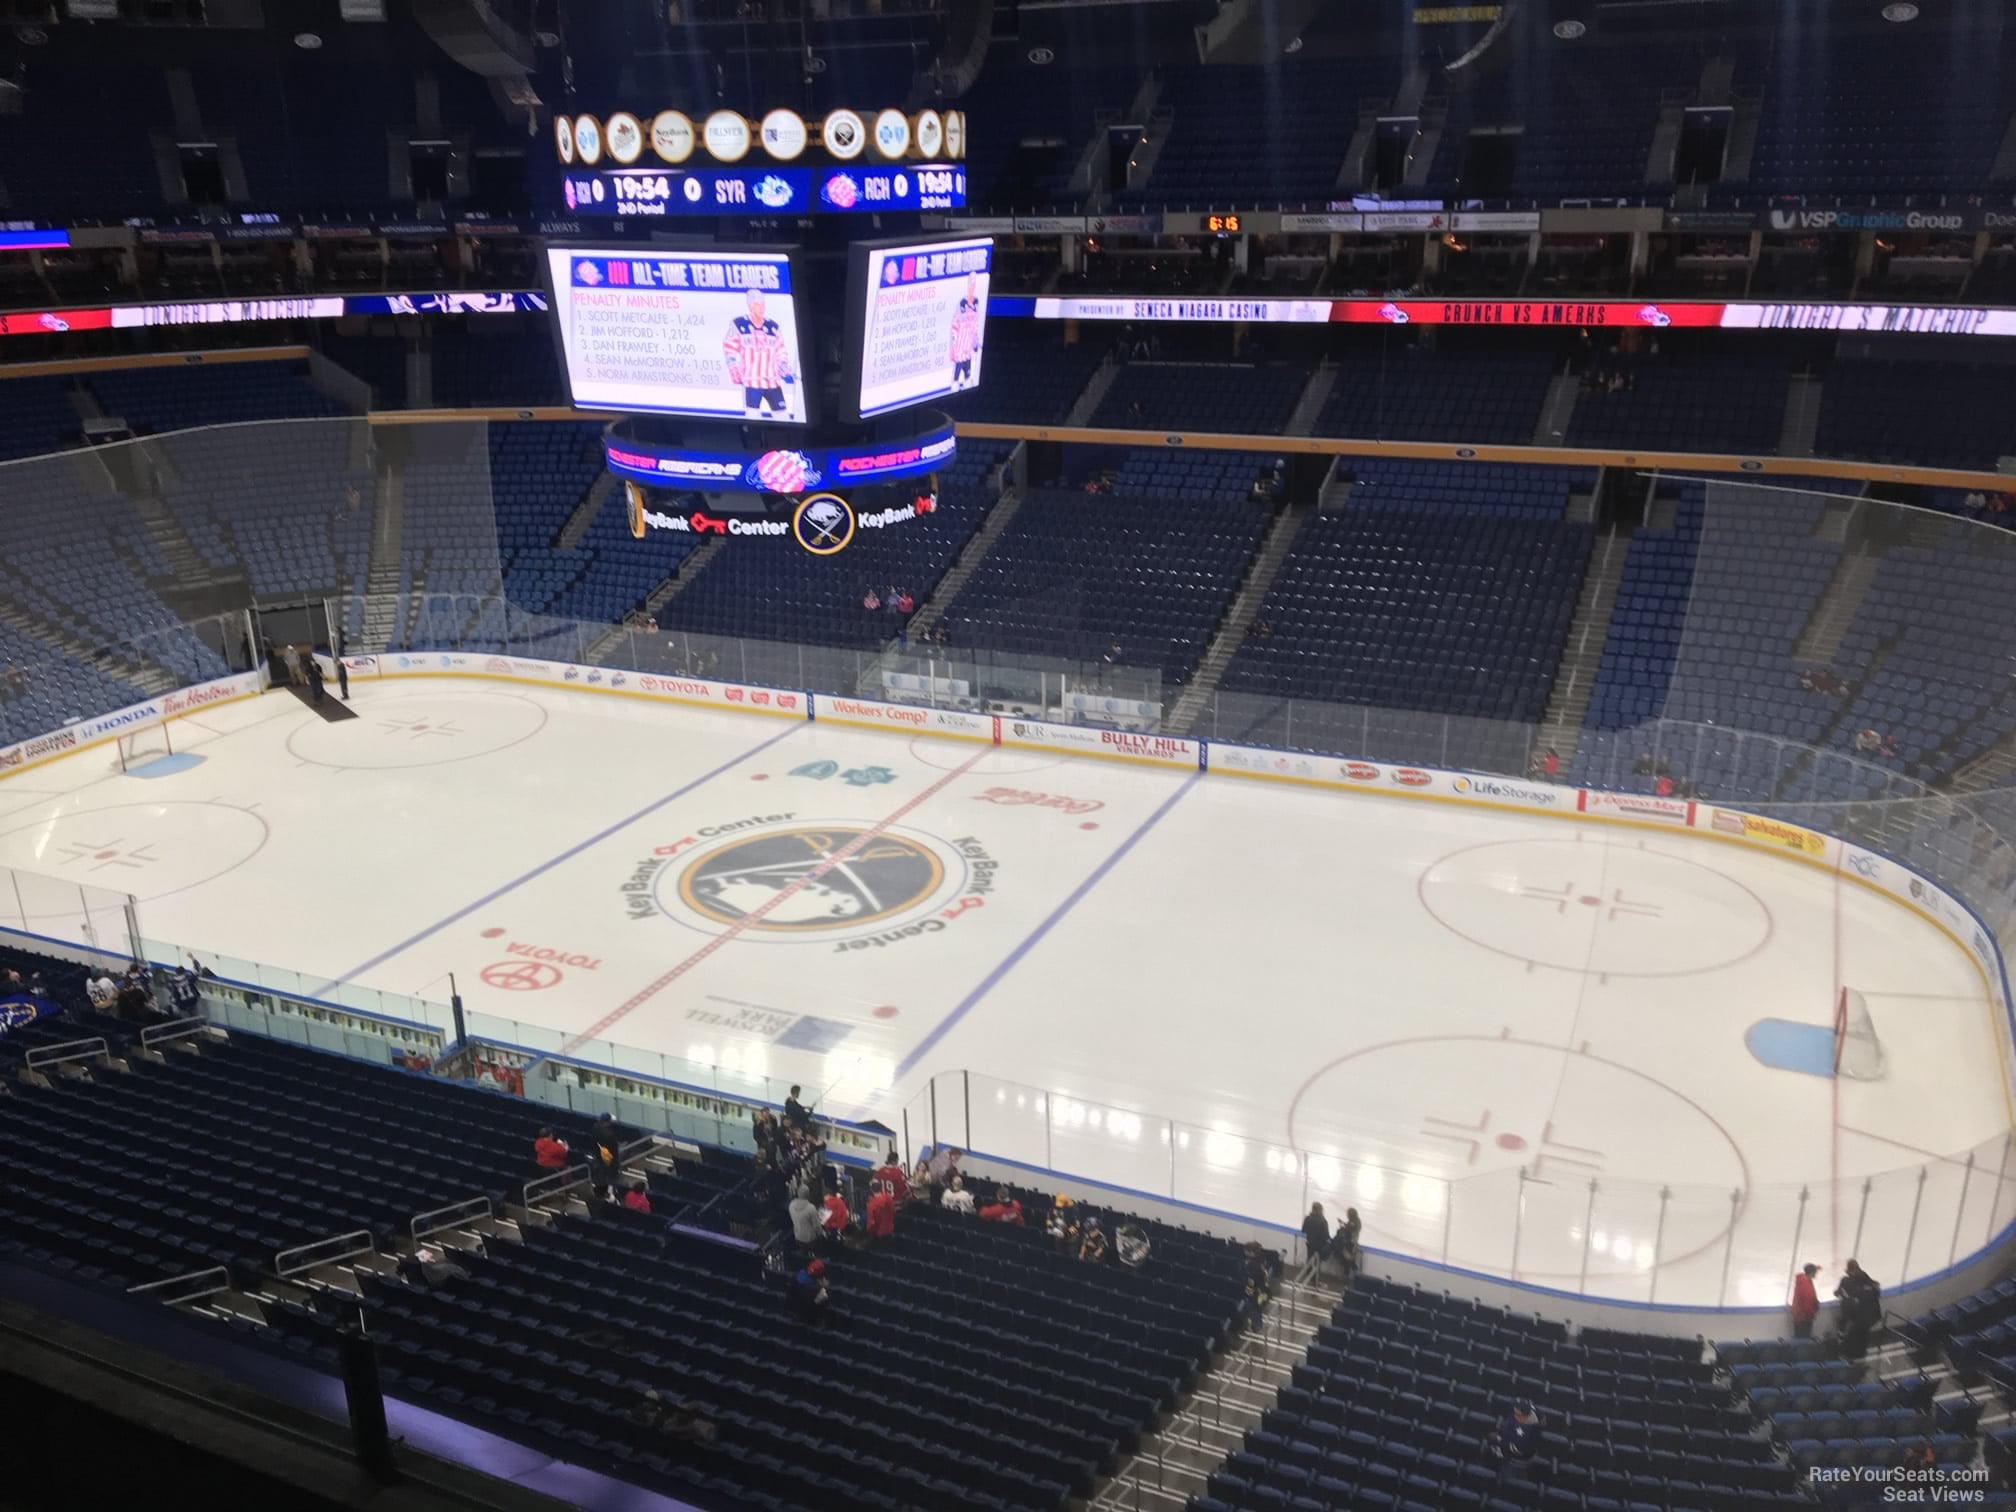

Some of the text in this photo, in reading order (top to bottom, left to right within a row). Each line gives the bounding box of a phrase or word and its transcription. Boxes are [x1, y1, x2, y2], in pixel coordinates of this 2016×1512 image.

[592, 178, 604, 202] 0
[613, 177, 670, 200] 19:54
[683, 177, 746, 204] 0 SYR
[894, 174, 908, 197] 0
[917, 172, 953, 194] 19:54
[1209, 214, 1239, 232] 6:15
[632, 261, 780, 289] ALL-TIME TEAM LEADERS
[573, 293, 680, 309] PENALTY MINUTES
[1134, 303, 1268, 320] SENECA NIAGARA CASINO
[144, 299, 314, 326] TONIGHTS MATCHUP
[577, 310, 586, 321] 1.
[588, 310, 618, 322] SCOTT
[621, 312, 669, 325] METCALFE
[677, 314, 705, 326] 1,424
[1444, 304, 1606, 325] CRUNCH VS AMERKS
[1759, 304, 1988, 335] TONIGHTS MATCHUP
[579, 325, 587, 336] 2.
[591, 327, 605, 337] JIM
[608, 327, 654, 338] HOFFORD
[662, 329, 690, 341] 1,212
[582, 340, 591, 350] 3.
[593, 340, 614, 351] DAN
[617, 342, 659, 353] FRAWLEY
[668, 344, 696, 356] 1,060
[595, 354, 620, 365] SEAN
[624, 356, 685, 369] McMORROW
[693, 359, 722, 371] 1,015
[586, 368, 597, 379] 5.
[598, 369, 628, 380] NORM
[632, 370, 693, 384] ARMSTRONG
[701, 375, 720, 386] 983
[658, 459, 742, 476] AMERICANS
[858, 503, 916, 529] KeyBank
[728, 518, 789, 537] Center
[658, 679, 710, 697] TOYOTA
[163, 695, 186, 715] Tim
[832, 700, 885, 717] Workers'
[886, 707, 928, 725] Comp?
[96, 705, 157, 732] HONDA
[1102, 732, 1189, 753] BULLY HILL
[1116, 744, 1176, 759] VINEYARDS
[697, 812, 797, 837] Center
[953, 835, 998, 896] KeyBank
[620, 858, 667, 920] KeyBank
[833, 919, 947, 953] Center
[505, 942, 603, 970] TOYOTA
[881, 1180, 895, 1198] 19
